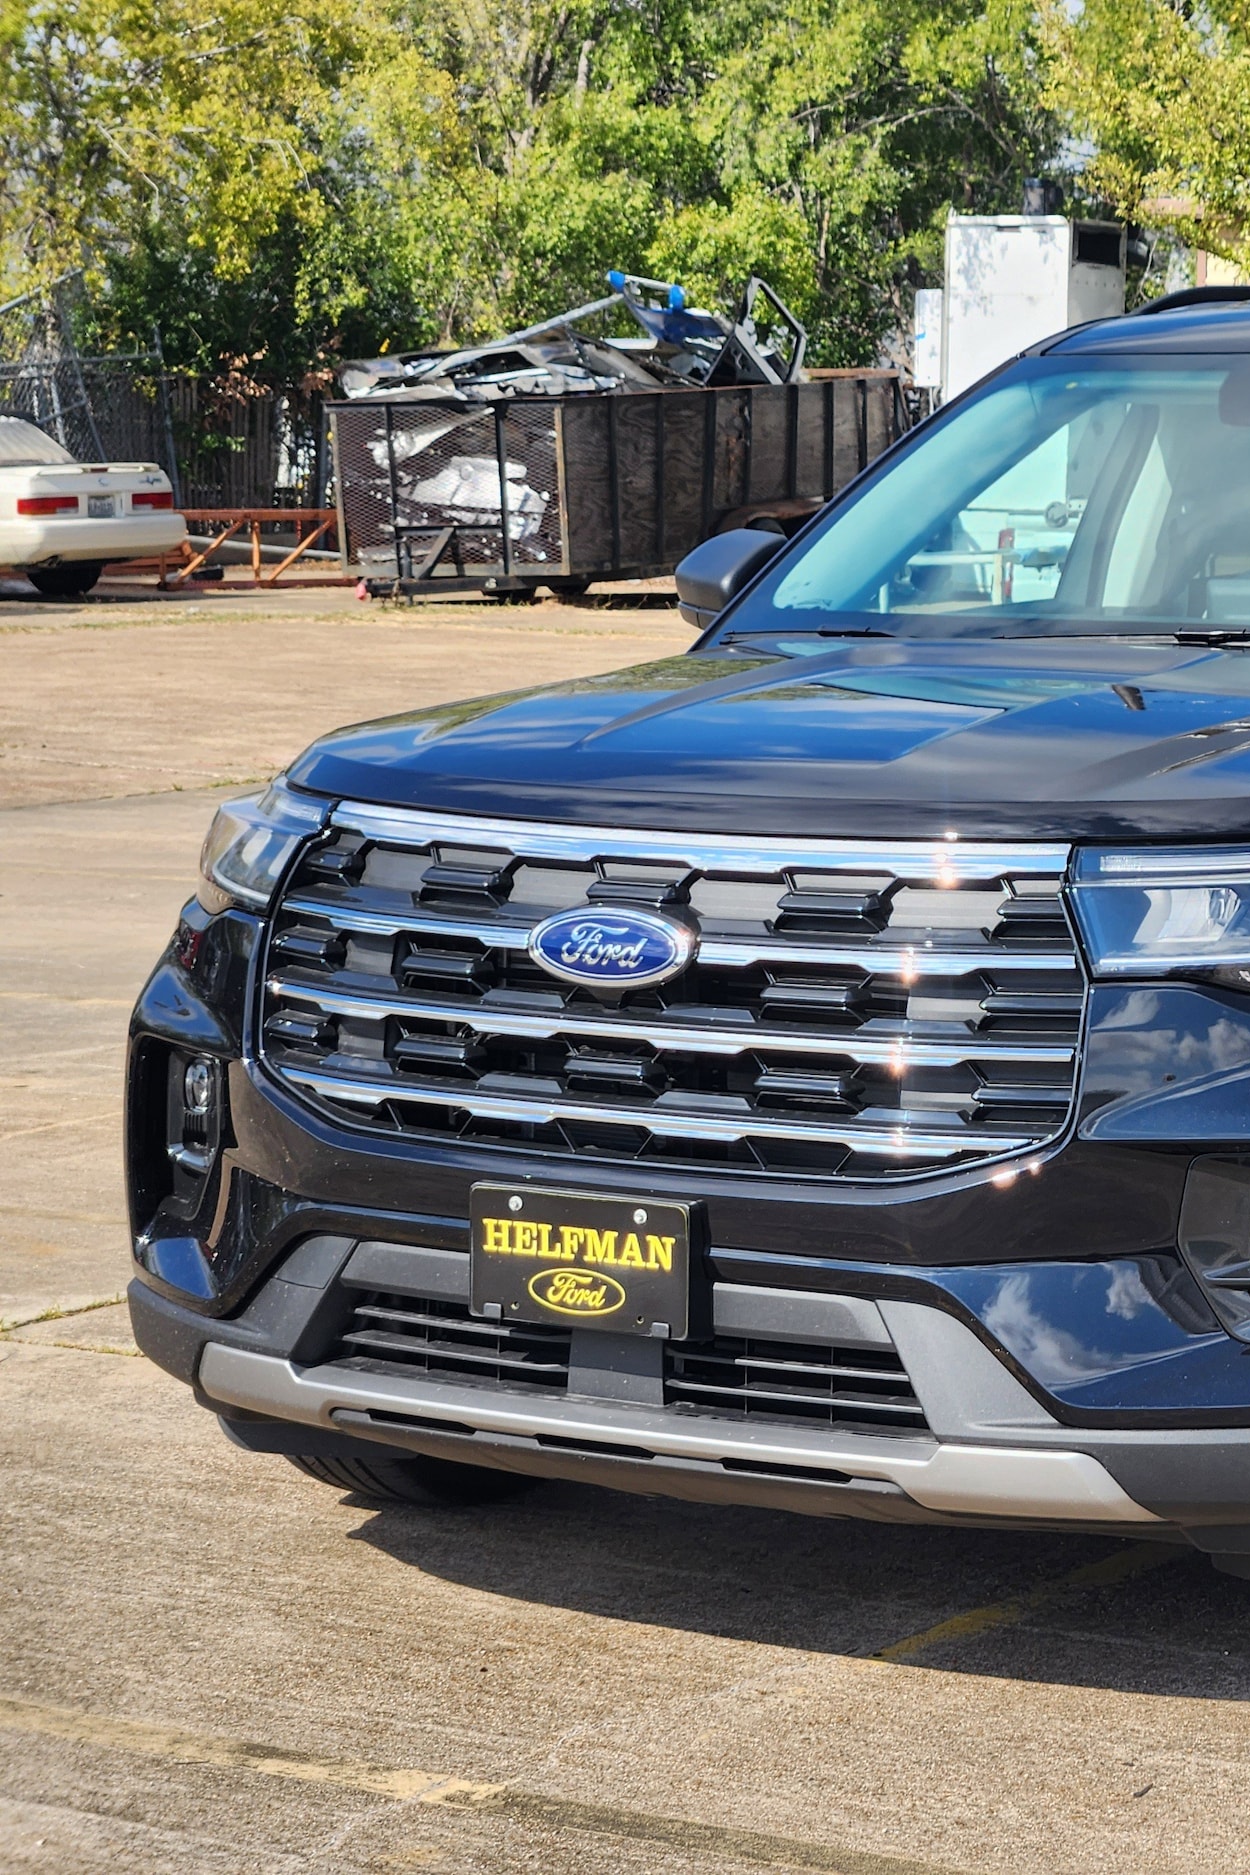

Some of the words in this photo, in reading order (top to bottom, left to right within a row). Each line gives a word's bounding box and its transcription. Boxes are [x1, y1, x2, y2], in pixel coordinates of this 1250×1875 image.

[561, 922, 648, 969] Ford
[482, 1218, 675, 1272] HELFMAN
[547, 1272, 607, 1308] Ford
